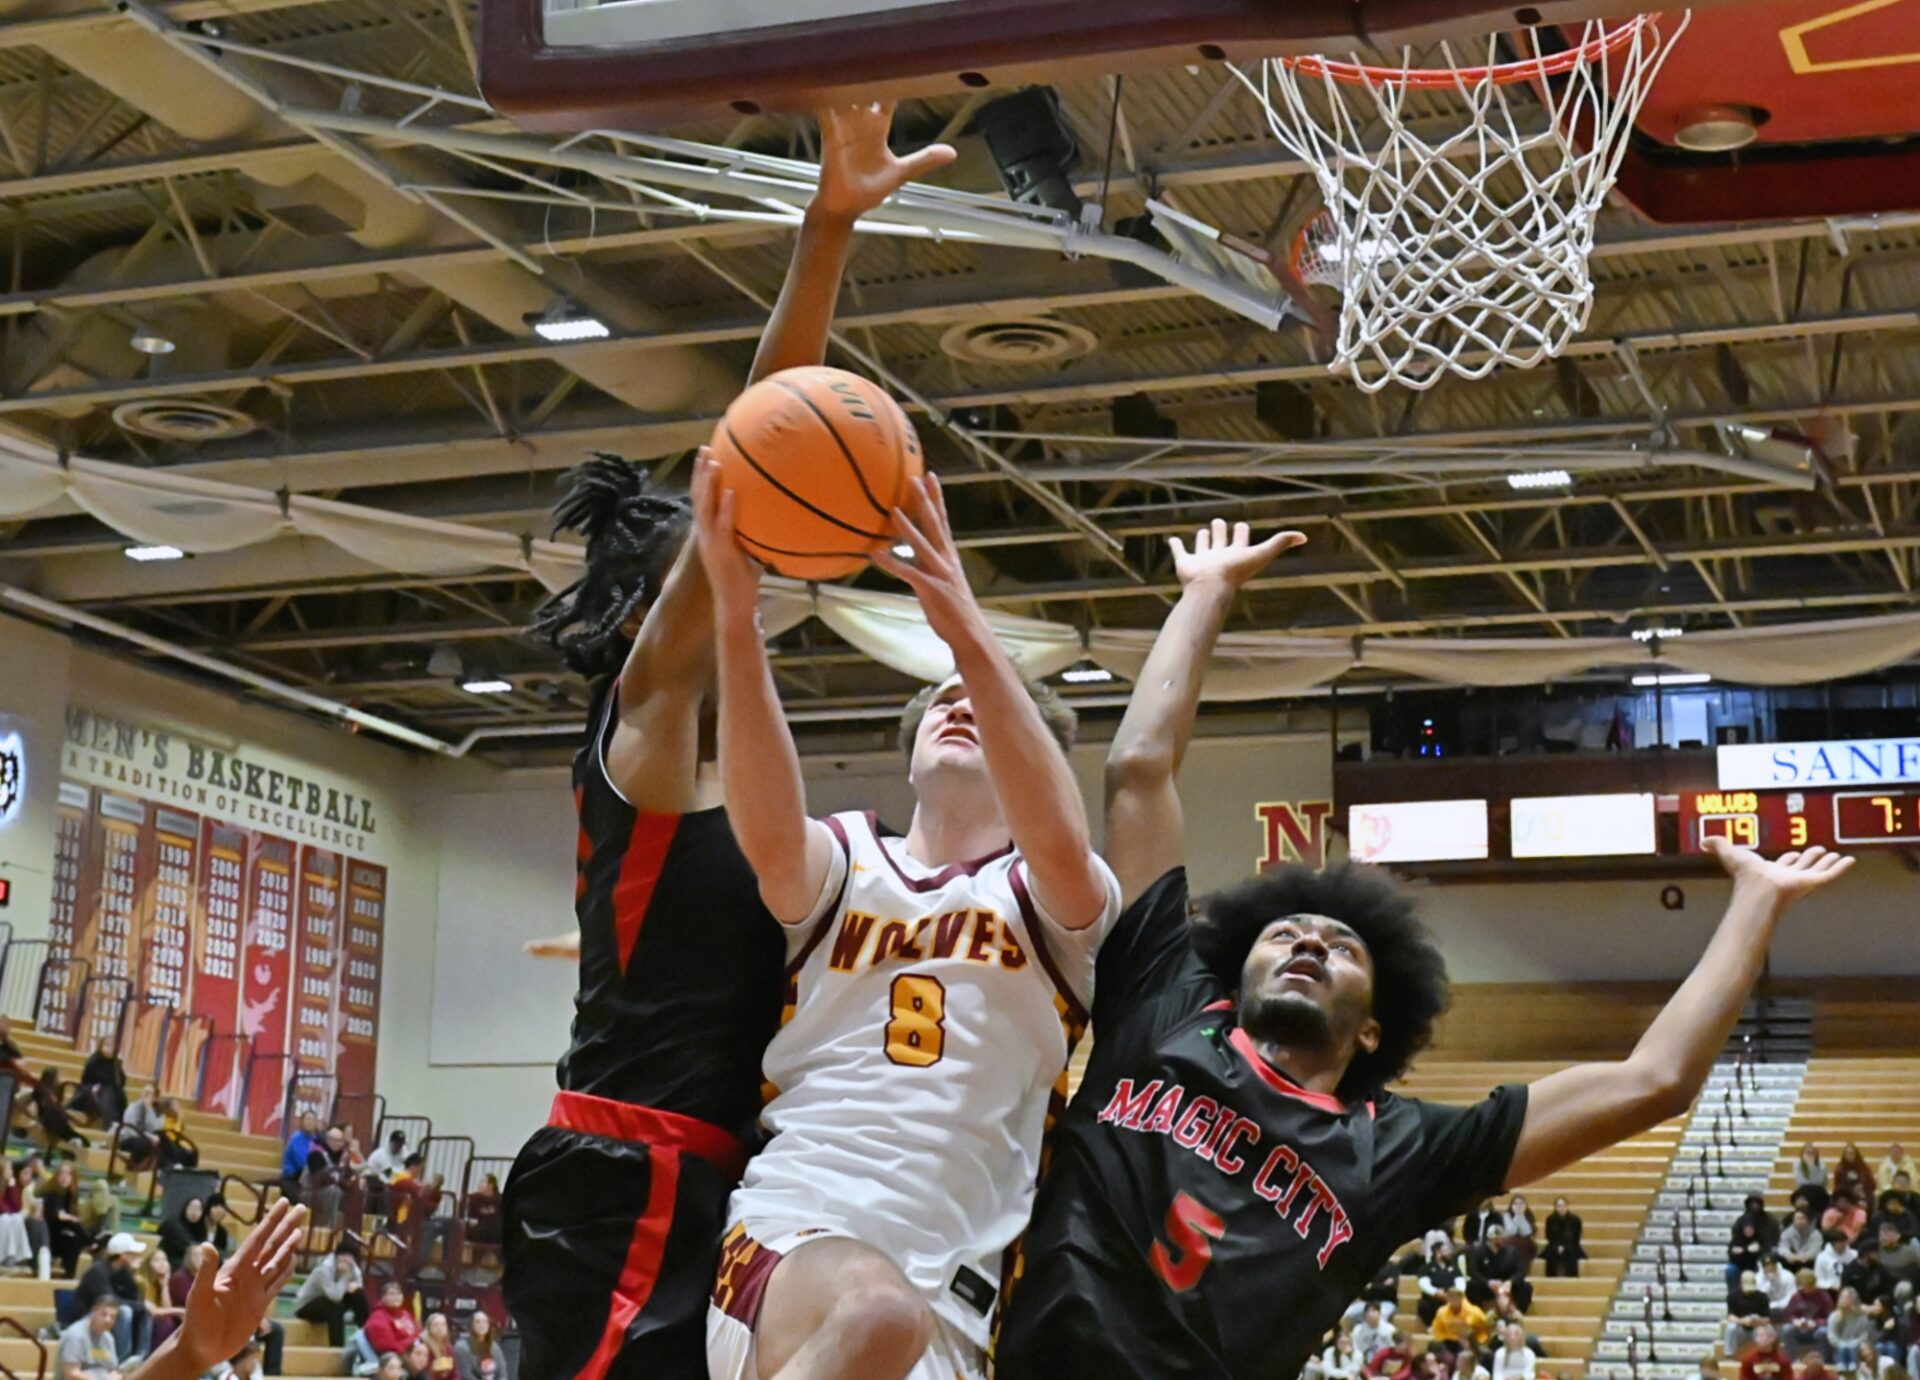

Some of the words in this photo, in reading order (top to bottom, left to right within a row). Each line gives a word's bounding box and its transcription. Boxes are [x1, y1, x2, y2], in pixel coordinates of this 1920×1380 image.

[187, 743, 376, 834] BASKETBALL
[1772, 743, 1920, 782] SANF
[68, 750, 78, 768] A
[90, 754, 207, 804] TRADITION
[217, 794, 240, 815] OF
[248, 804, 366, 852] EXCELLENCE
[1697, 793, 1758, 814] WOLVES
[1726, 816, 1755, 846] 19
[1790, 816, 1807, 846] 3
[1255, 801, 1333, 875] N
[204, 956, 234, 980] 2021
[206, 937, 236, 959] 2020
[828, 907, 1029, 974] WOLVES
[883, 973, 945, 1068] 8
[1097, 1079, 1261, 1175] MAGIC
[1253, 1144, 1353, 1271] CITY
[1149, 1189, 1227, 1293] 5
